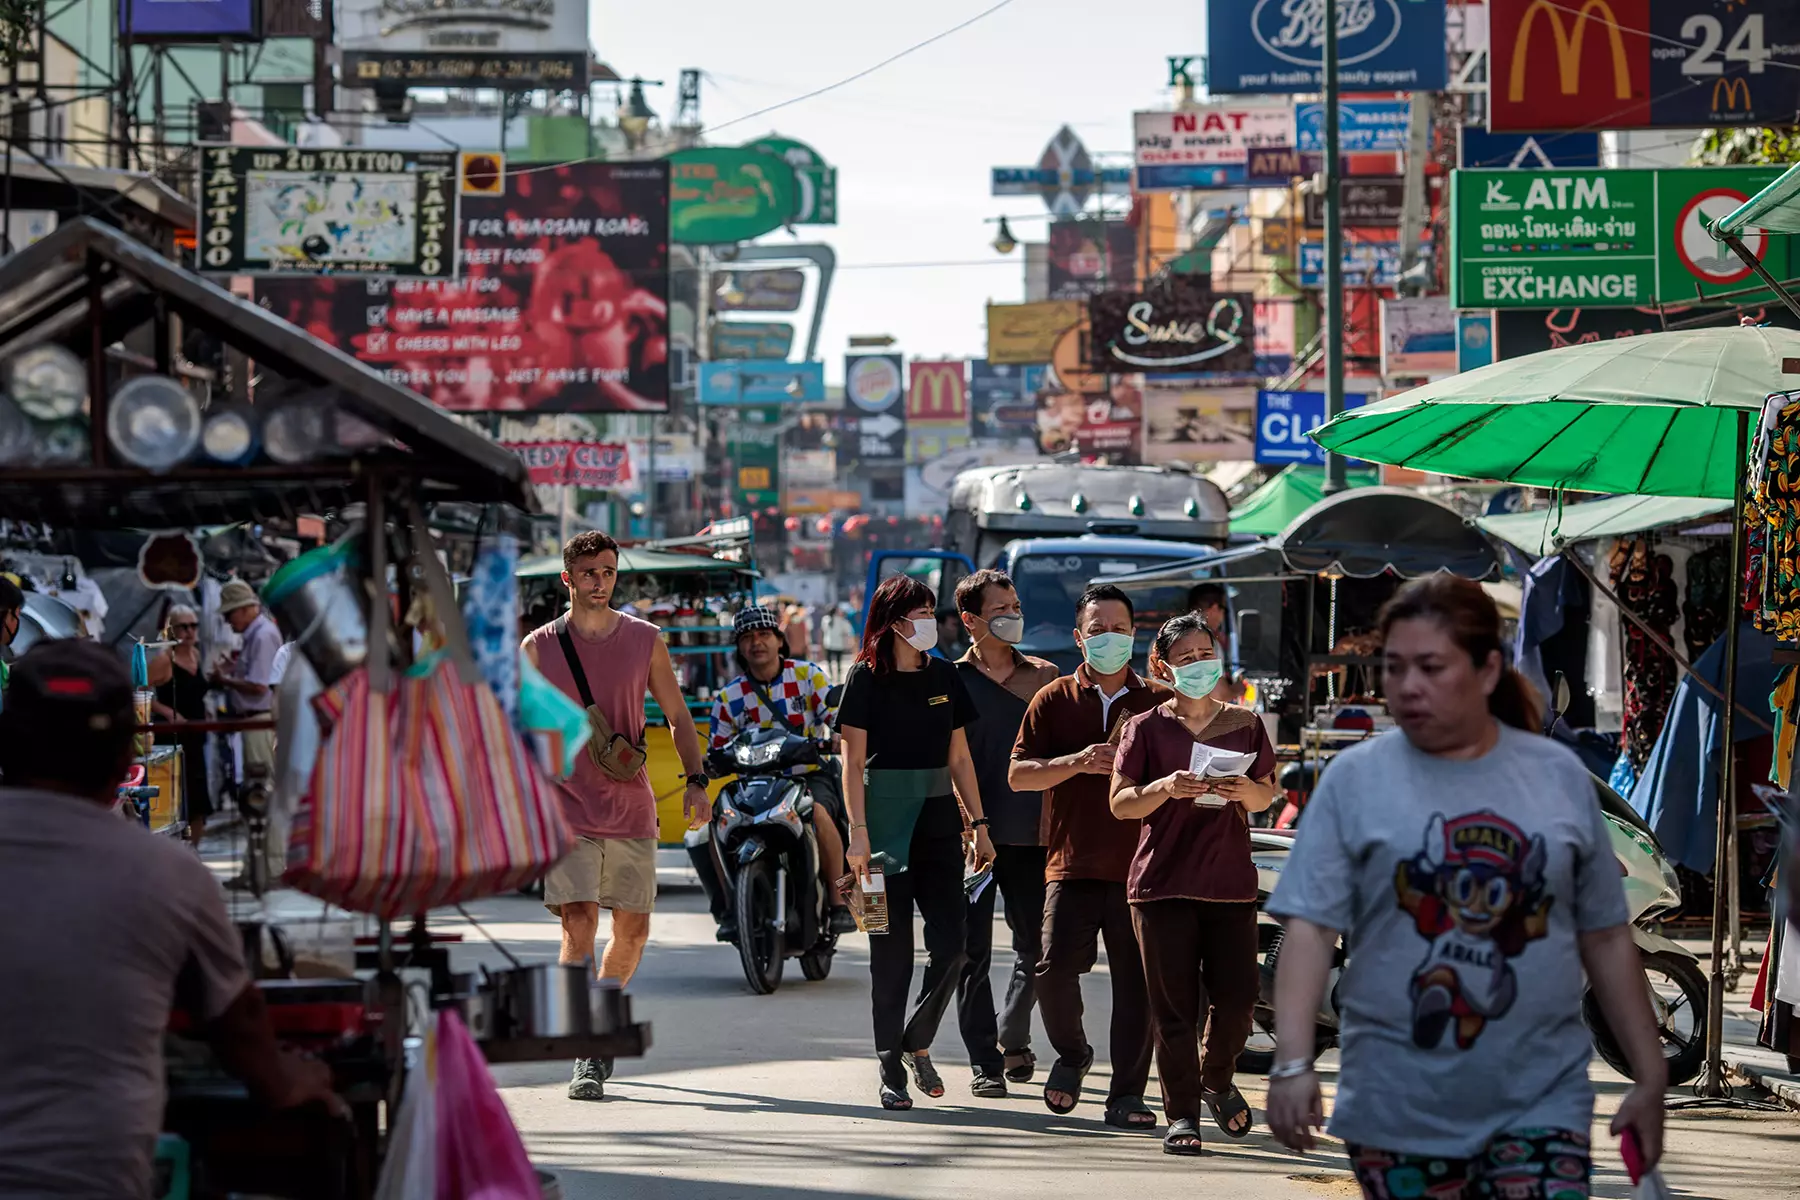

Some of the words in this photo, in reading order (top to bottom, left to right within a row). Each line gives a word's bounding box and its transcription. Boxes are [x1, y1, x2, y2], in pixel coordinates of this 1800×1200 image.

[1652, 46, 1686, 60] open
[1680, 14, 1772, 75] 24
[1238, 73, 1269, 88] your
[1270, 71, 1312, 86] health
[1337, 70, 1371, 85] eauty
[1372, 68, 1418, 84] expert
[1172, 112, 1250, 133] NAT
[253, 154, 282, 170] UP
[321, 153, 405, 172] TATTOO
[1253, 154, 1300, 174] ATM
[1523, 177, 1610, 210] ATM
[204, 147, 239, 267] TATTOO
[420, 171, 447, 276] TATTOO
[467, 218, 505, 238] FOR
[507, 218, 590, 237] KHAOSAN
[459, 248, 501, 265] TREET
[503, 248, 547, 265] FOOD
[1481, 266, 1534, 276] CURRENCY
[1483, 274, 1638, 300] EXCHANGE
[395, 307, 435, 323] HAVE
[436, 307, 450, 323] A
[452, 306, 521, 323] MASSAGE
[395, 335, 450, 352] CHEERS
[452, 335, 490, 351] WITH
[491, 335, 523, 351] LEO
[505, 367, 541, 385] JUST
[1265, 393, 1293, 411] THE
